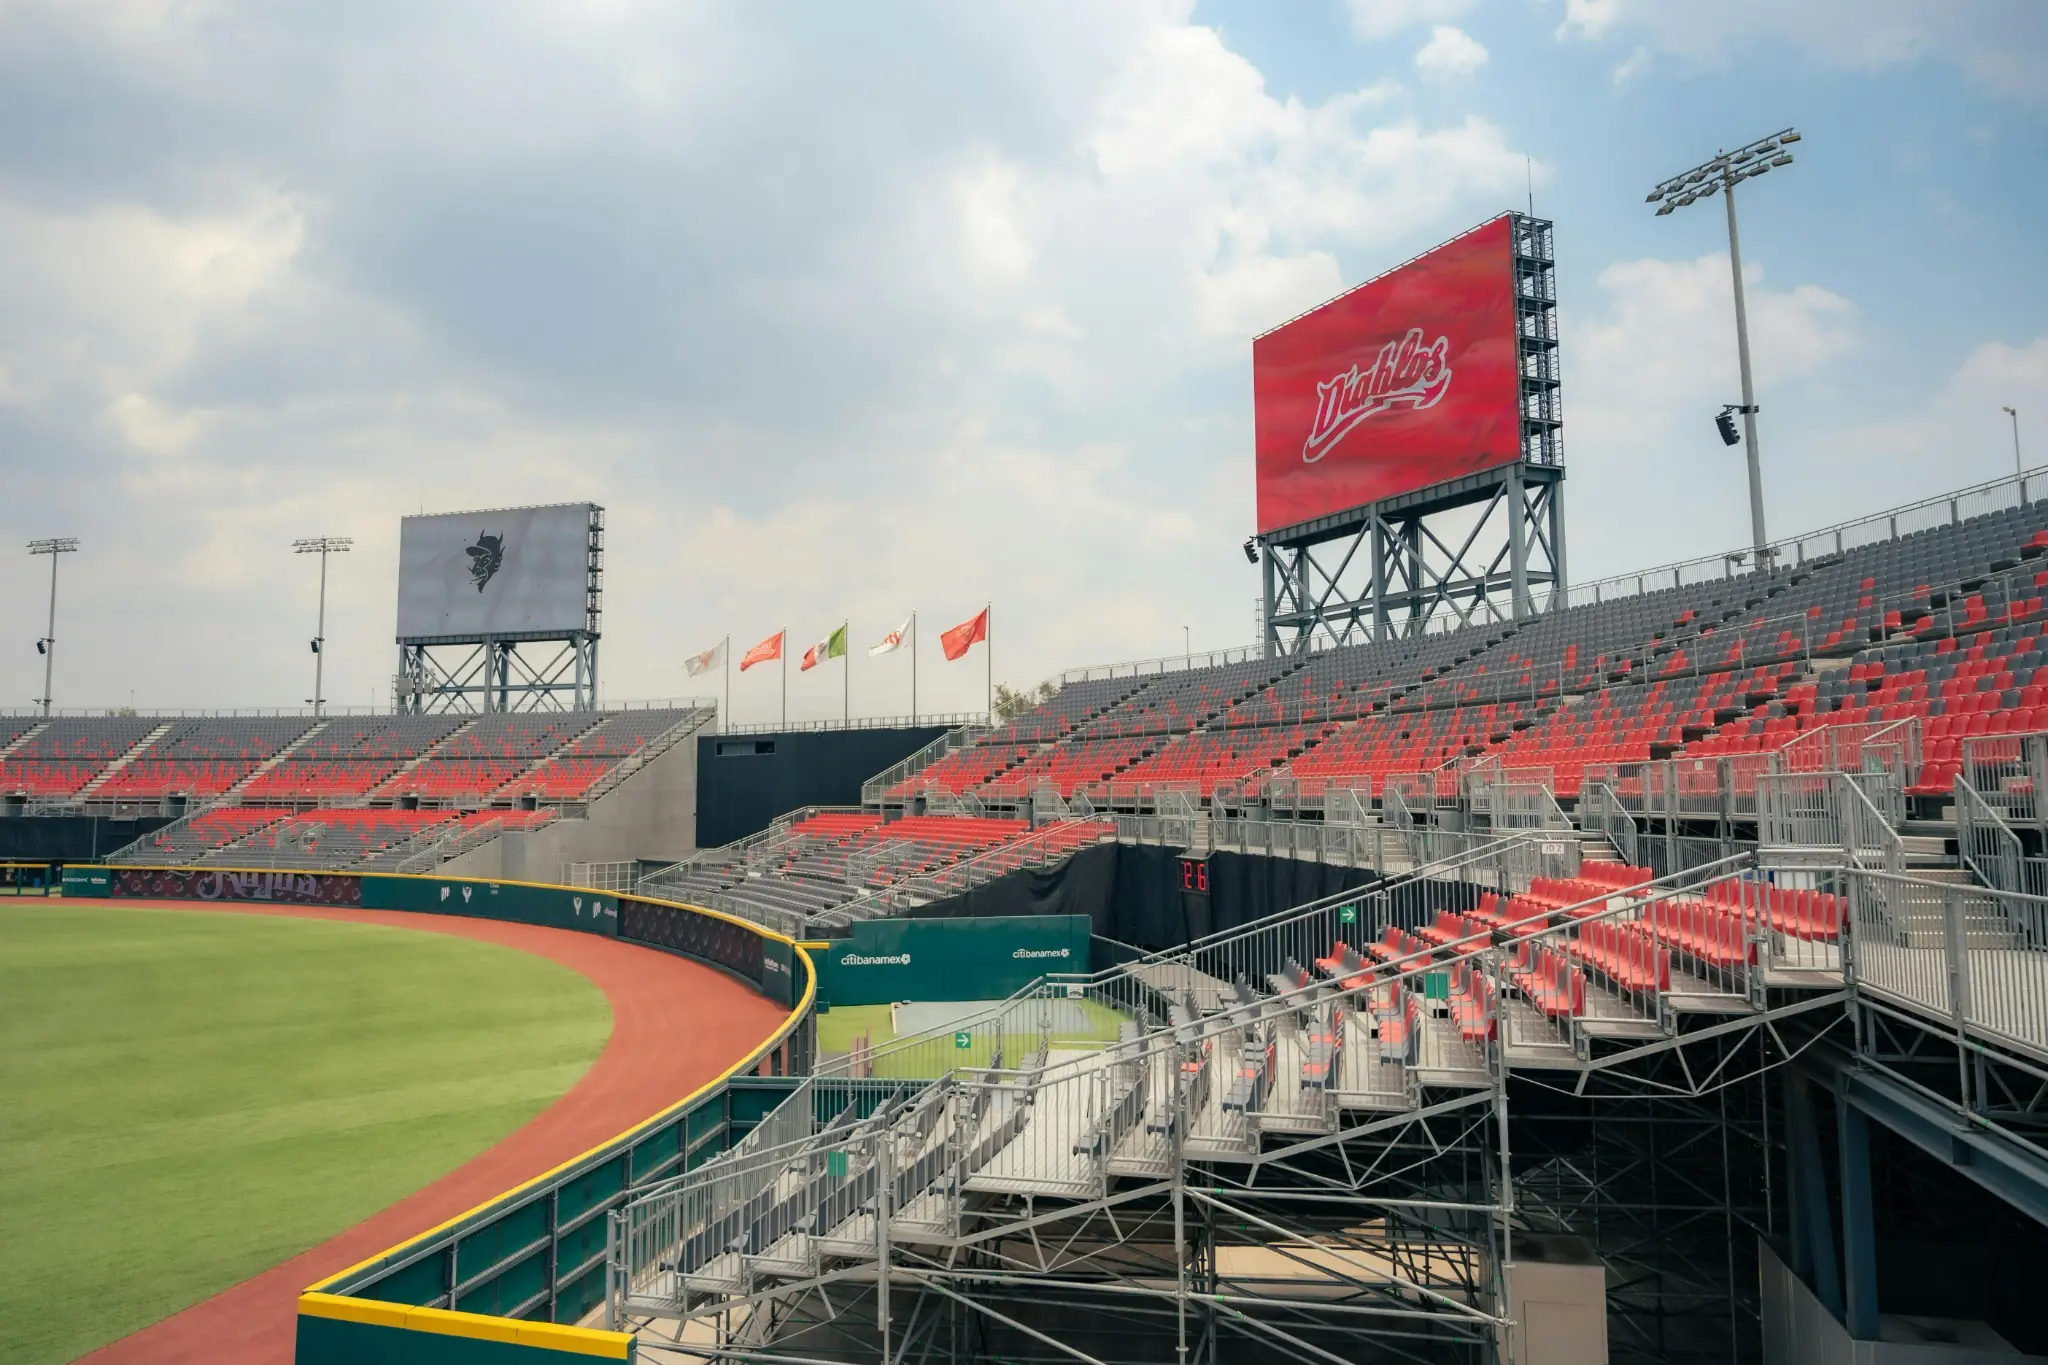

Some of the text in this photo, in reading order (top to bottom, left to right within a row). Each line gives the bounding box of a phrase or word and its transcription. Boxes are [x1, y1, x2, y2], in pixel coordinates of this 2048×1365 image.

[1303, 328, 1452, 463] Diablos
[841, 953, 901, 966] citibanamex
[1012, 948, 1061, 959] citibanamex
